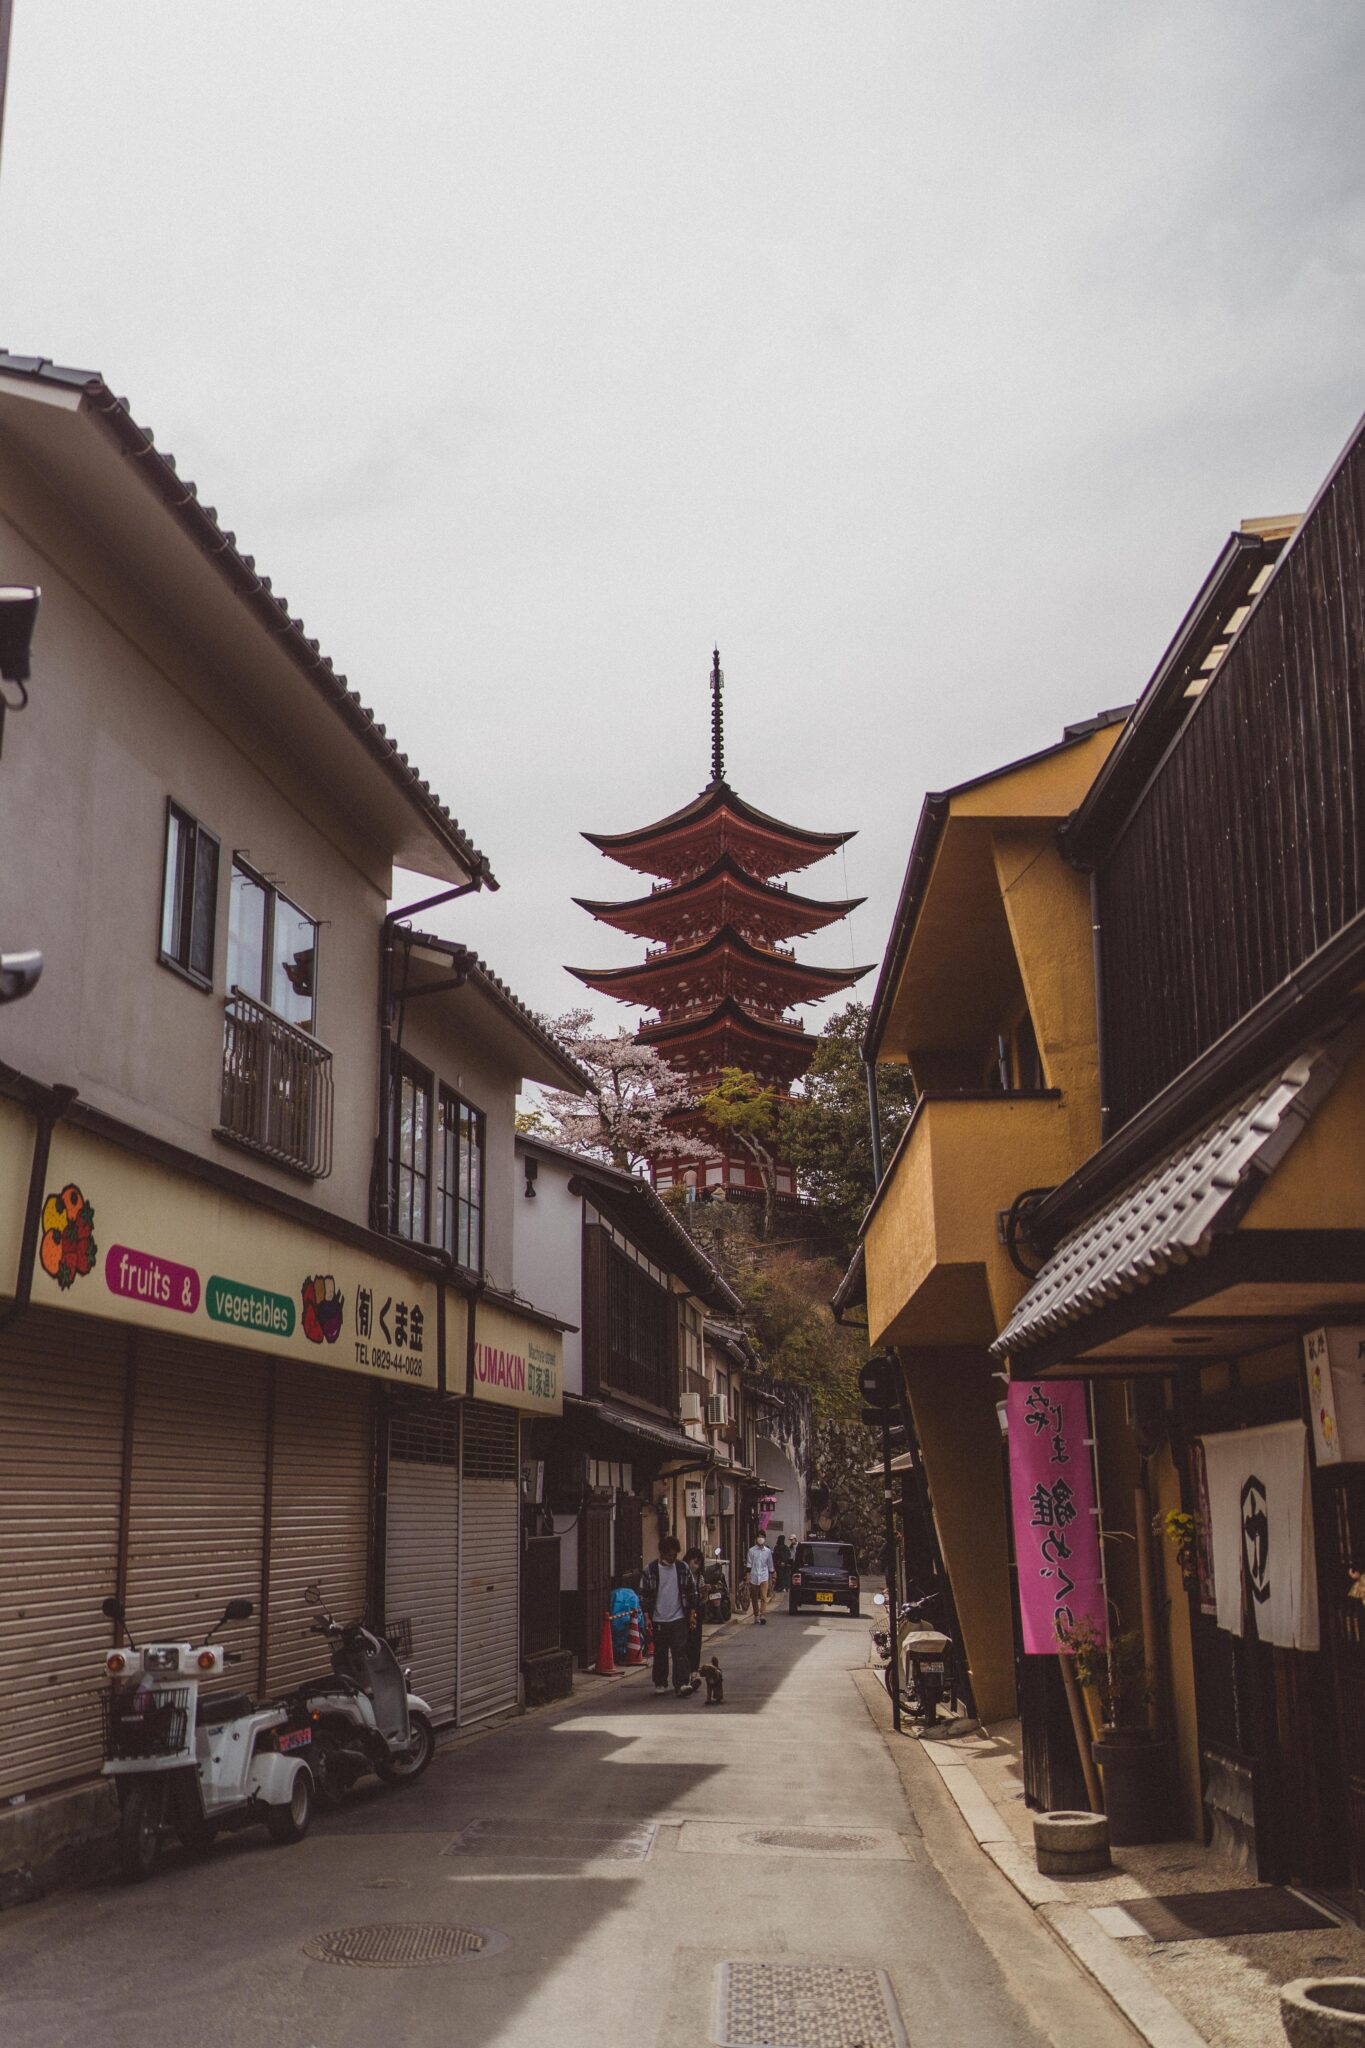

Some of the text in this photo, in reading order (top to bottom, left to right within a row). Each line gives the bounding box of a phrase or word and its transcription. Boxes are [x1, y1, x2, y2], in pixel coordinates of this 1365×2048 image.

[119, 1254, 192, 1308] fruits &
[215, 1289, 288, 1332] vegetables
[379, 1296, 424, 1352] くま金
[355, 1341, 423, 1377] TEL 0829-44-0028
[528, 1362, 556, 1399] 町家通り
